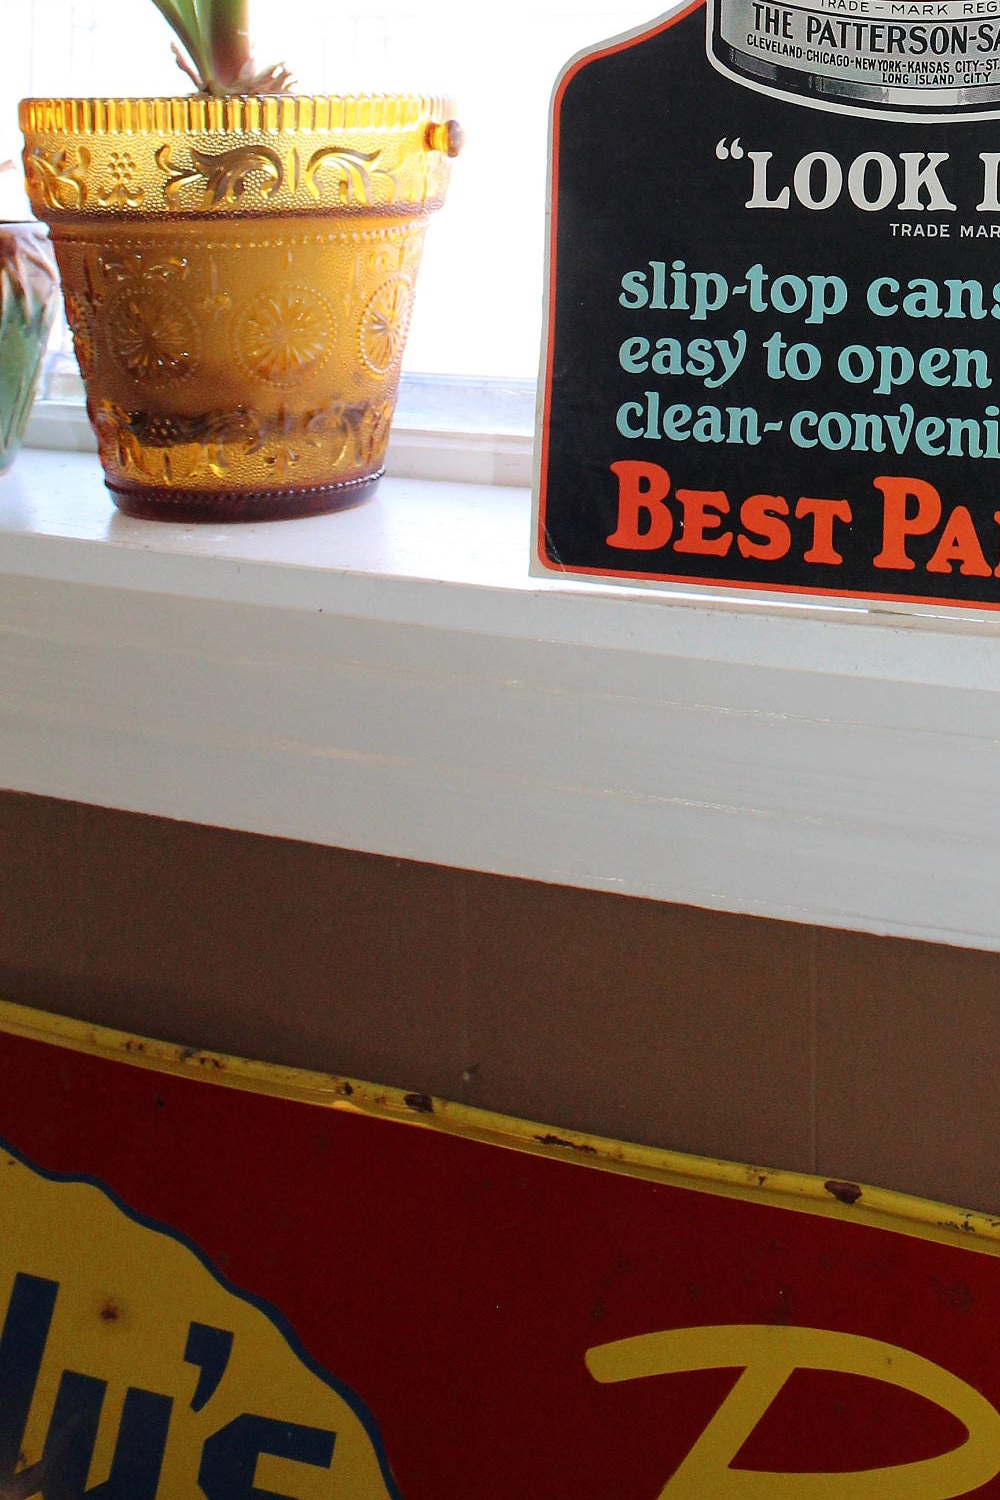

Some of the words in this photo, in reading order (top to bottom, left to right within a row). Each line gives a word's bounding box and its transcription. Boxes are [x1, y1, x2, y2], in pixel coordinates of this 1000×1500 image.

[752, 2, 794, 40] THE
[891, 4, 949, 15] MARK
[882, 73, 909, 84] LONG
[915, 74, 955, 85] ISLAND
[963, 72, 992, 84] CITY
[889, 223, 950, 239] TRADE
[618, 259, 848, 324] slip-top
[618, 329, 747, 389] easy
[762, 331, 822, 381] to
[837, 344, 993, 394] open
[605, 459, 853, 565] BEST
